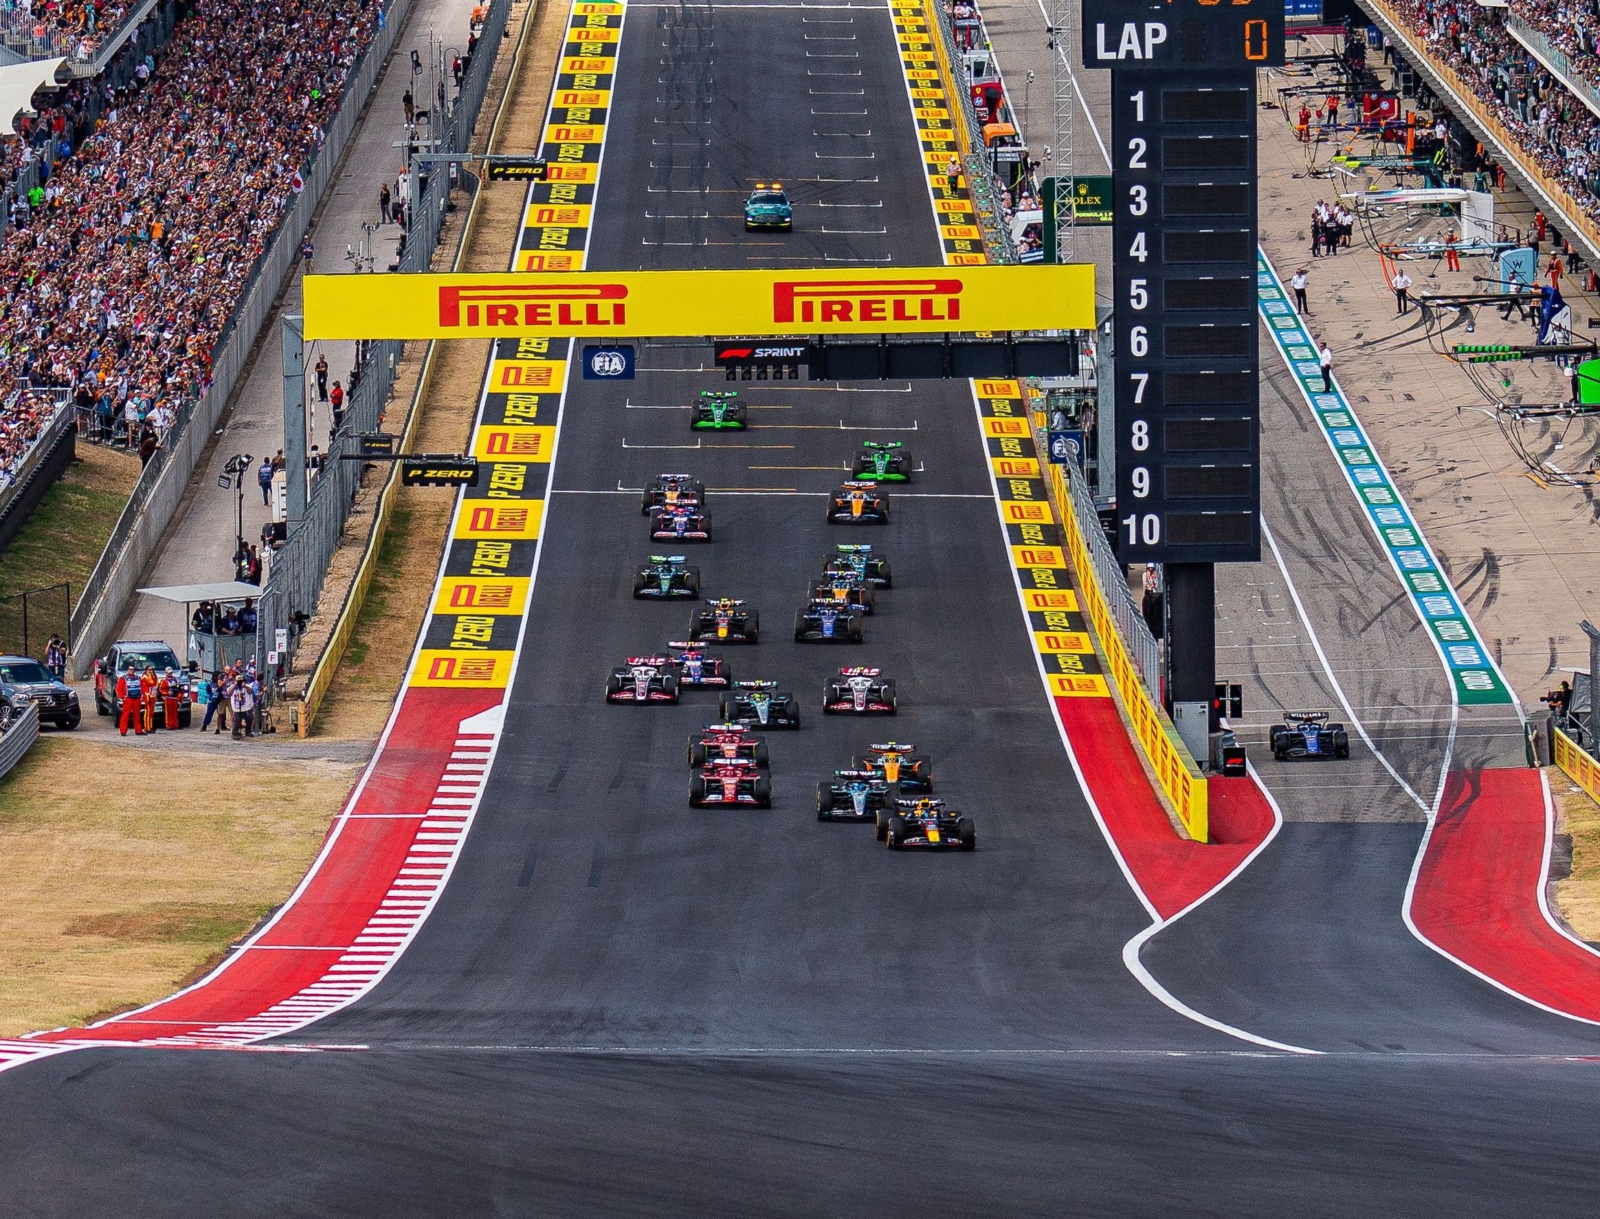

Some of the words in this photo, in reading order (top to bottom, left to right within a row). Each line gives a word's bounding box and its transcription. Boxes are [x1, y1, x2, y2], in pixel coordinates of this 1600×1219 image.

[1097, 23, 1167, 59] LAP
[1245, 20, 1267, 59] 0
[1131, 91, 1143, 121] 1
[1129, 138, 1146, 168] 2
[1130, 185, 1147, 215] 3
[1130, 232, 1147, 262] 4
[439, 285, 628, 326] PIRELLI
[774, 280, 963, 322] PIRELLI
[1131, 279, 1147, 309] 5
[518, 338, 549, 353] ZER
[754, 348, 804, 357] SPRINT
[1131, 326, 1147, 356] 6
[594, 356, 623, 372] FIA
[1131, 374, 1148, 403] 7
[505, 394, 539, 418] ZERO
[1132, 420, 1148, 450] 8
[424, 470, 473, 478] ZERO
[490, 464, 527, 490] ZERO
[1132, 467, 1149, 497] 9
[470, 508, 528, 531] PIRELLI
[1123, 514, 1160, 544] 10
[472, 541, 512, 568] ZERO
[450, 585, 512, 607] PIRELLI
[189, 634, 196, 650] A
[453, 616, 495, 641] ZERO
[428, 658, 495, 680] PIRELLI
